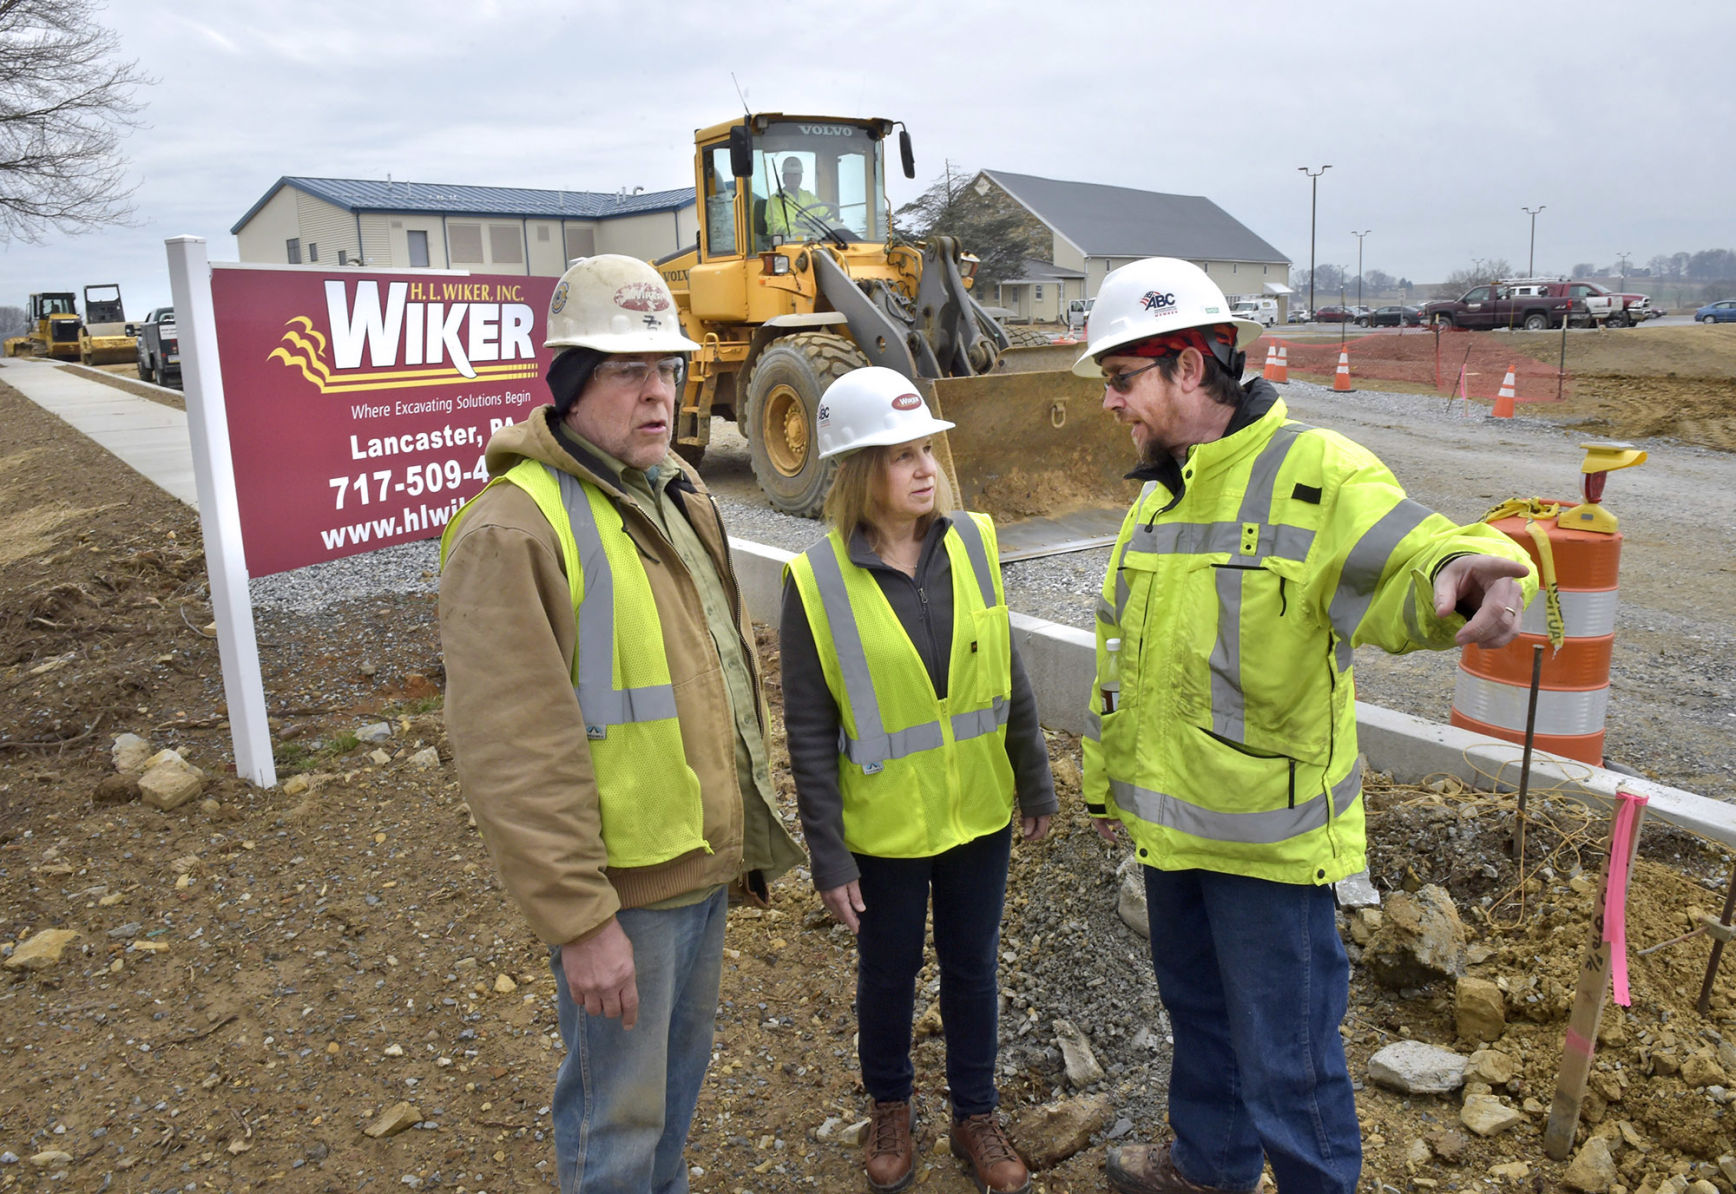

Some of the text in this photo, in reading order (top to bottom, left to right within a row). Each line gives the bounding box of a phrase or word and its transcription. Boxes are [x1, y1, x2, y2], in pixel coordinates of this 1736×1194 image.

[798, 125, 852, 136] VOLVO
[410, 282, 524, 302] H. L. WIKER, INC.
[1145, 293, 1175, 311] ABC
[323, 279, 536, 379] WIKER
[351, 391, 531, 419] Where Excavating Solutions Begin
[350, 424, 483, 460] Lancaster,
[329, 454, 490, 510] 717-509-4
